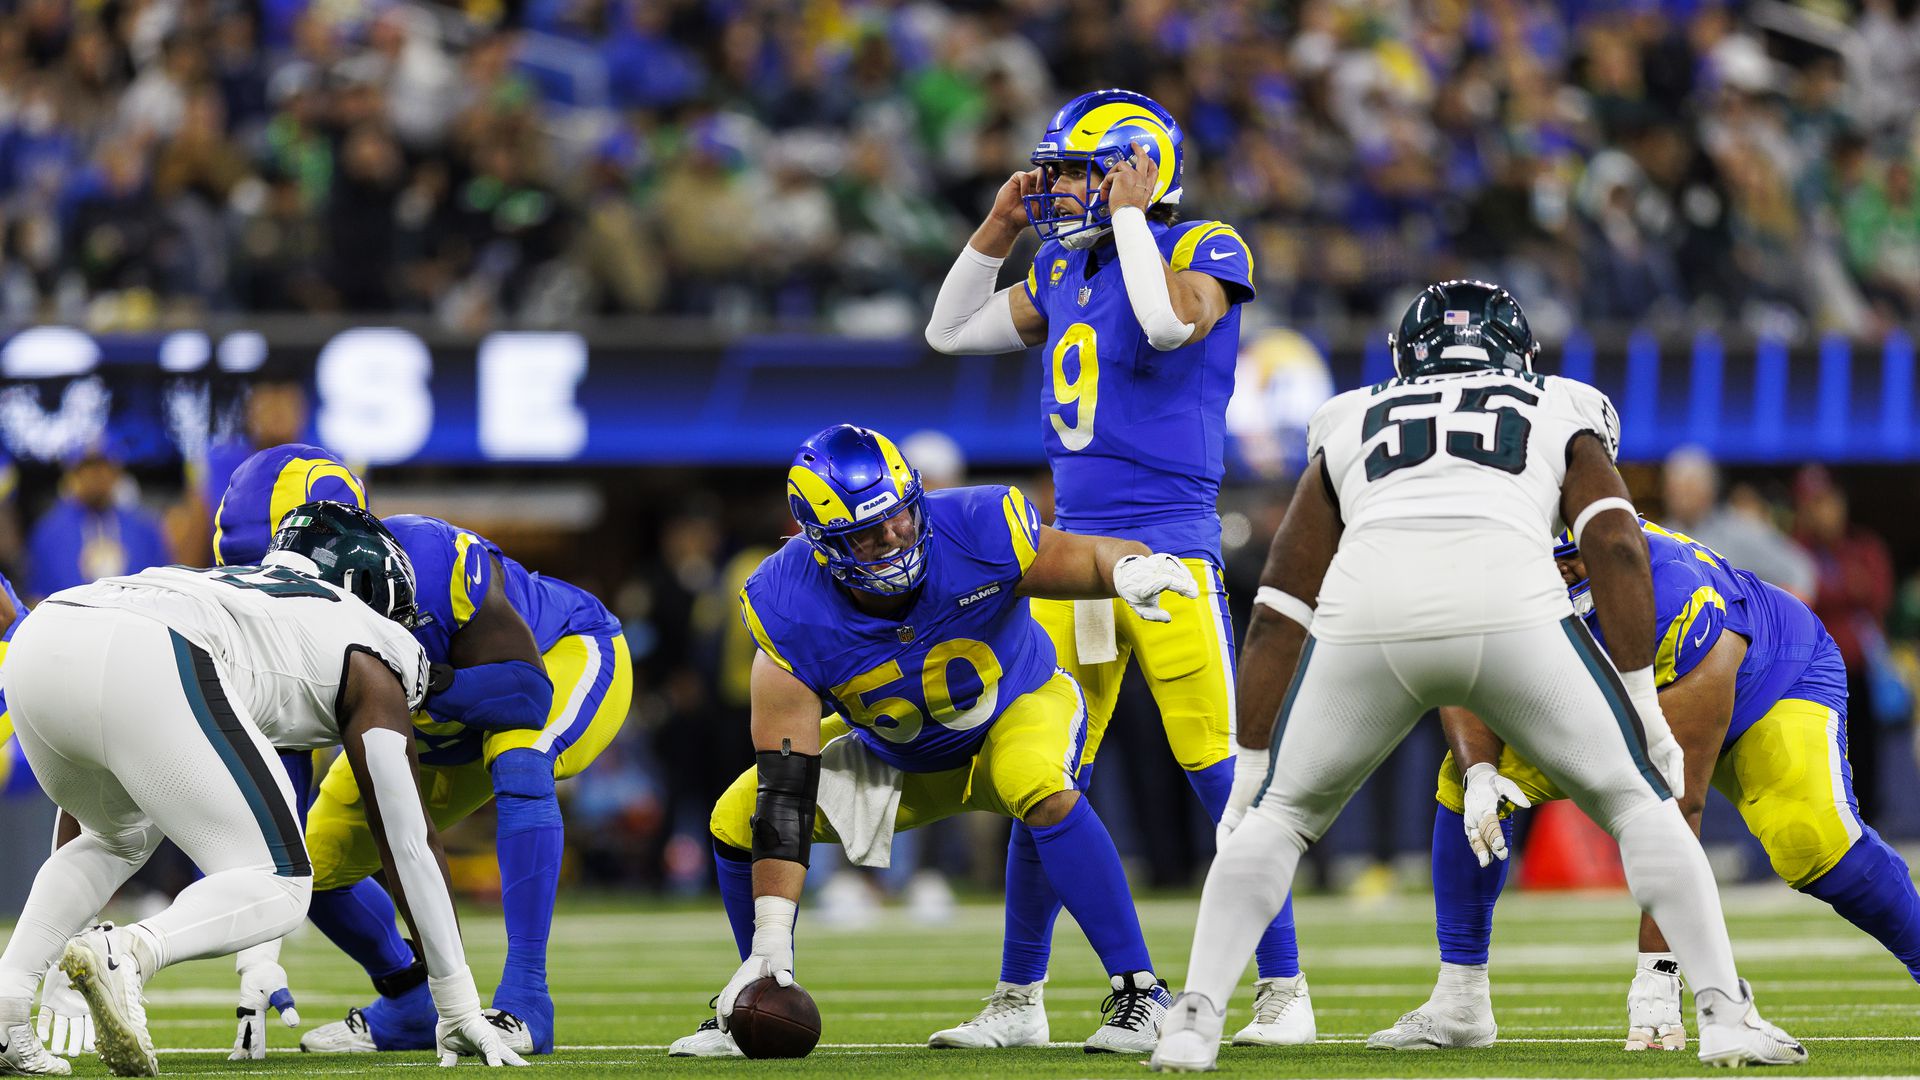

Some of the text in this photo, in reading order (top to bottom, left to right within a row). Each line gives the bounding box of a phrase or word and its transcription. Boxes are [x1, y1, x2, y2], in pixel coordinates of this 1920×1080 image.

[1051, 259, 1068, 281] C
[1049, 322, 1099, 451] 9
[1361, 384, 1539, 483] 55
[863, 496, 887, 511] RAMS
[959, 585, 1000, 607] RAMS
[829, 637, 1003, 744] 50
[1652, 959, 1678, 975] NIKE
